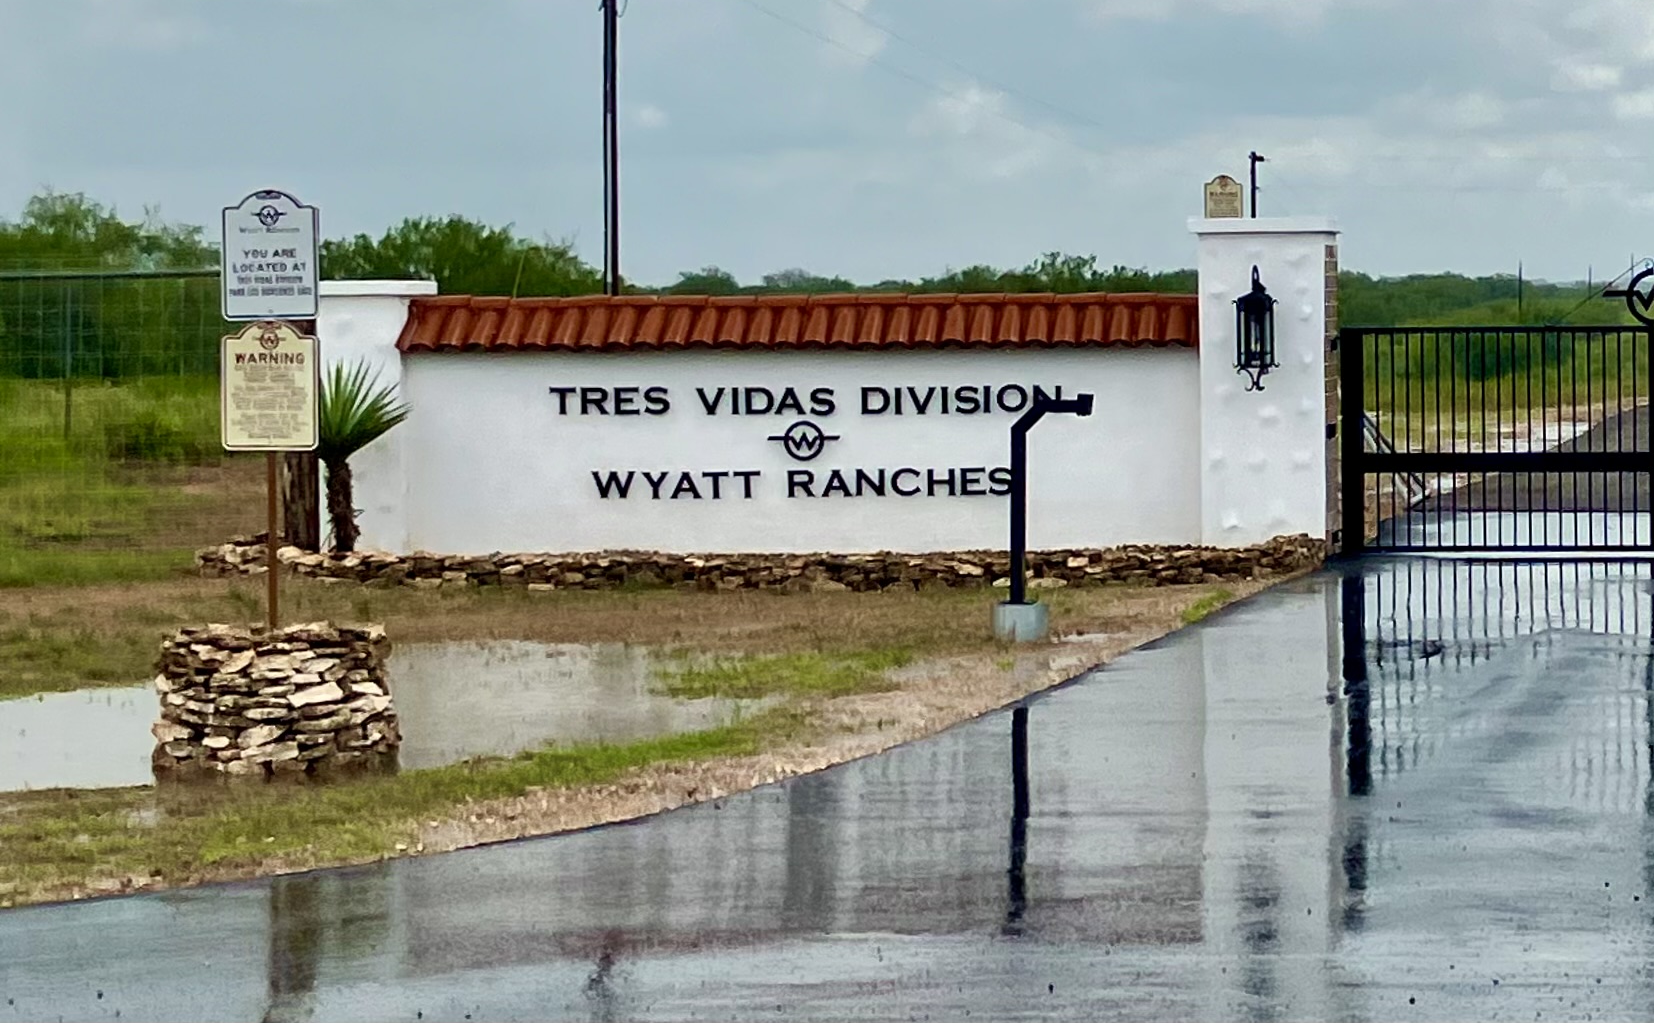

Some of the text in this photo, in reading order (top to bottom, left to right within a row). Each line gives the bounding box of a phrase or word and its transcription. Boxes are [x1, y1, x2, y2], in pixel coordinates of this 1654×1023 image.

[243, 248, 297, 259] YOU ARE
[232, 262, 306, 273] LOCATED AT
[234, 352, 305, 364] WARNING
[549, 384, 1062, 416] TRES VIDAS DIVISION
[592, 467, 1012, 499] WYATT RANCHES
